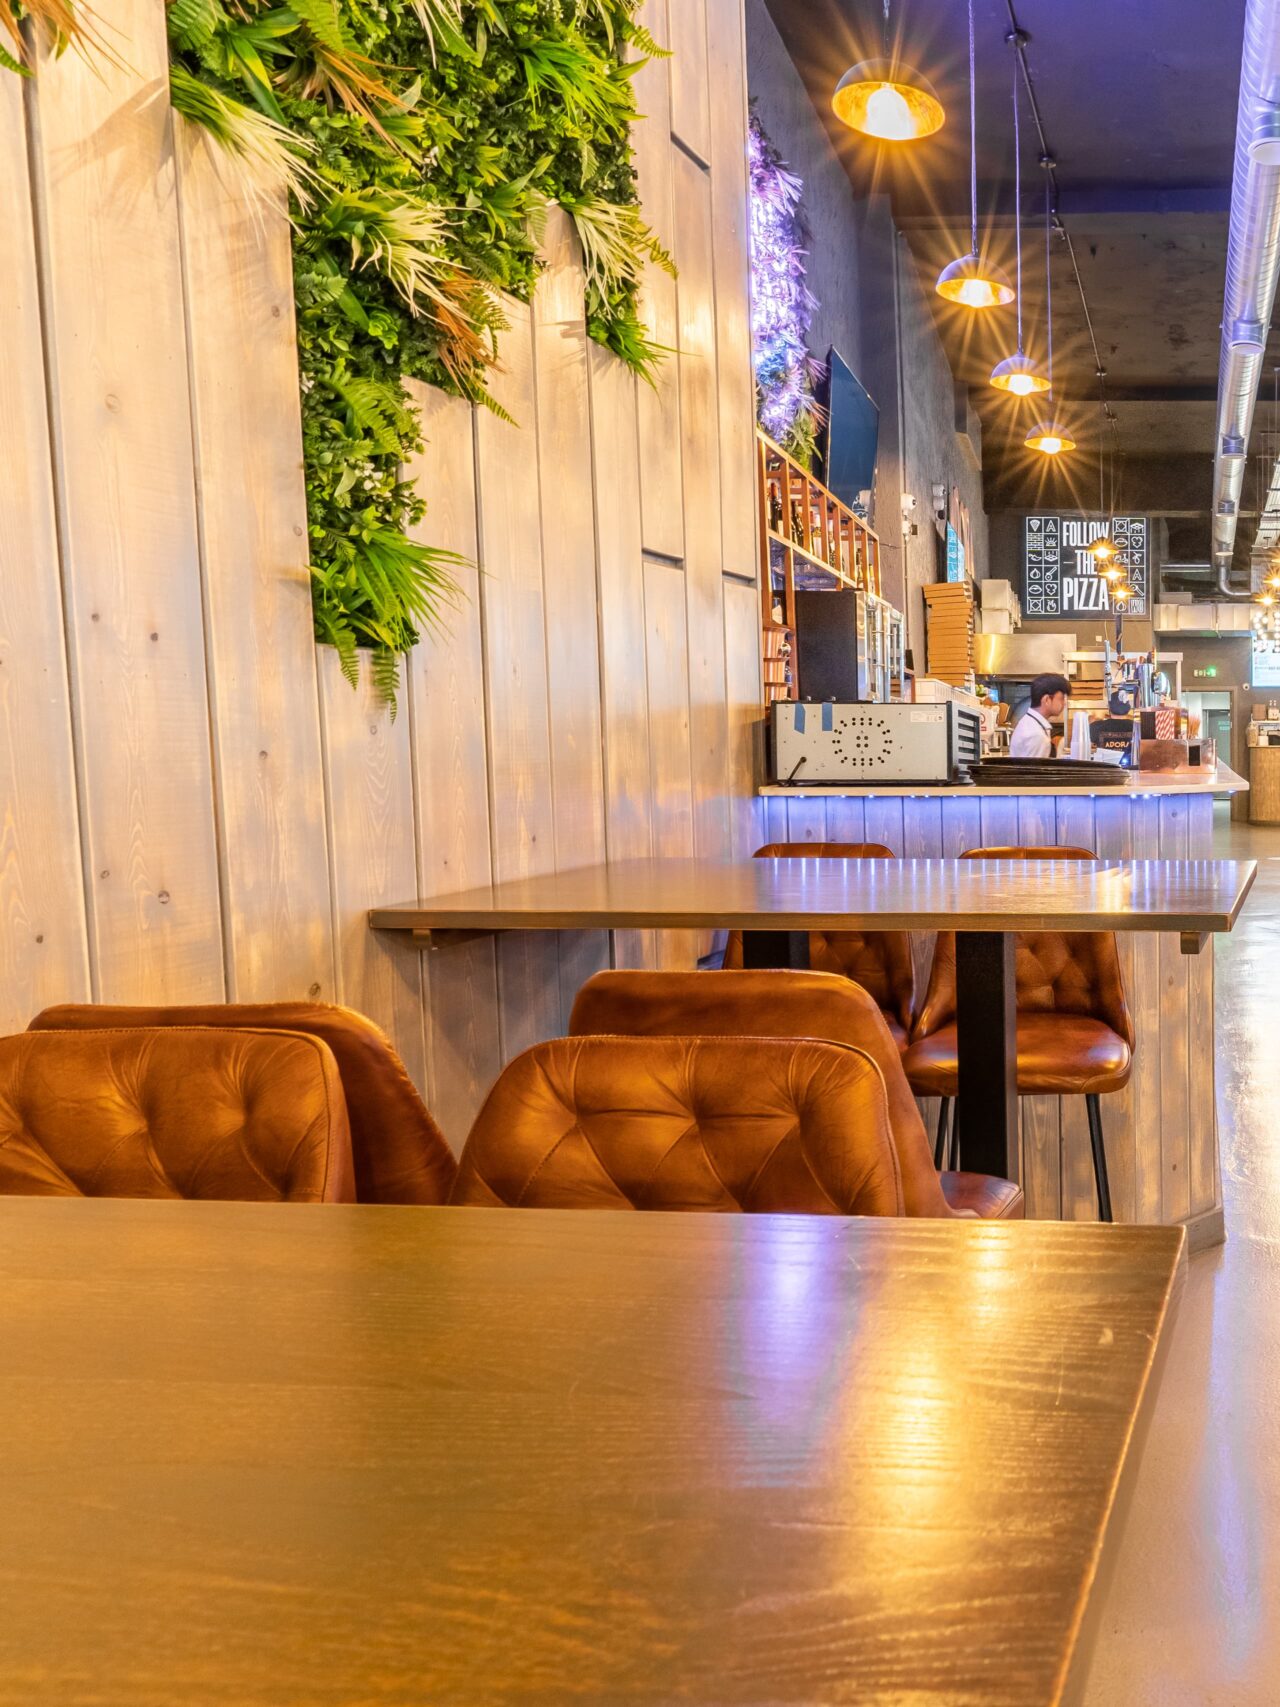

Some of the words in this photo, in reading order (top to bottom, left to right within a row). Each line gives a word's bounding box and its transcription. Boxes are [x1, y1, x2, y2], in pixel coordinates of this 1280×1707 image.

[1062, 521, 1110, 547] FOLLOW
[1074, 549, 1098, 575] THE
[1062, 577, 1110, 611] PIZZA
